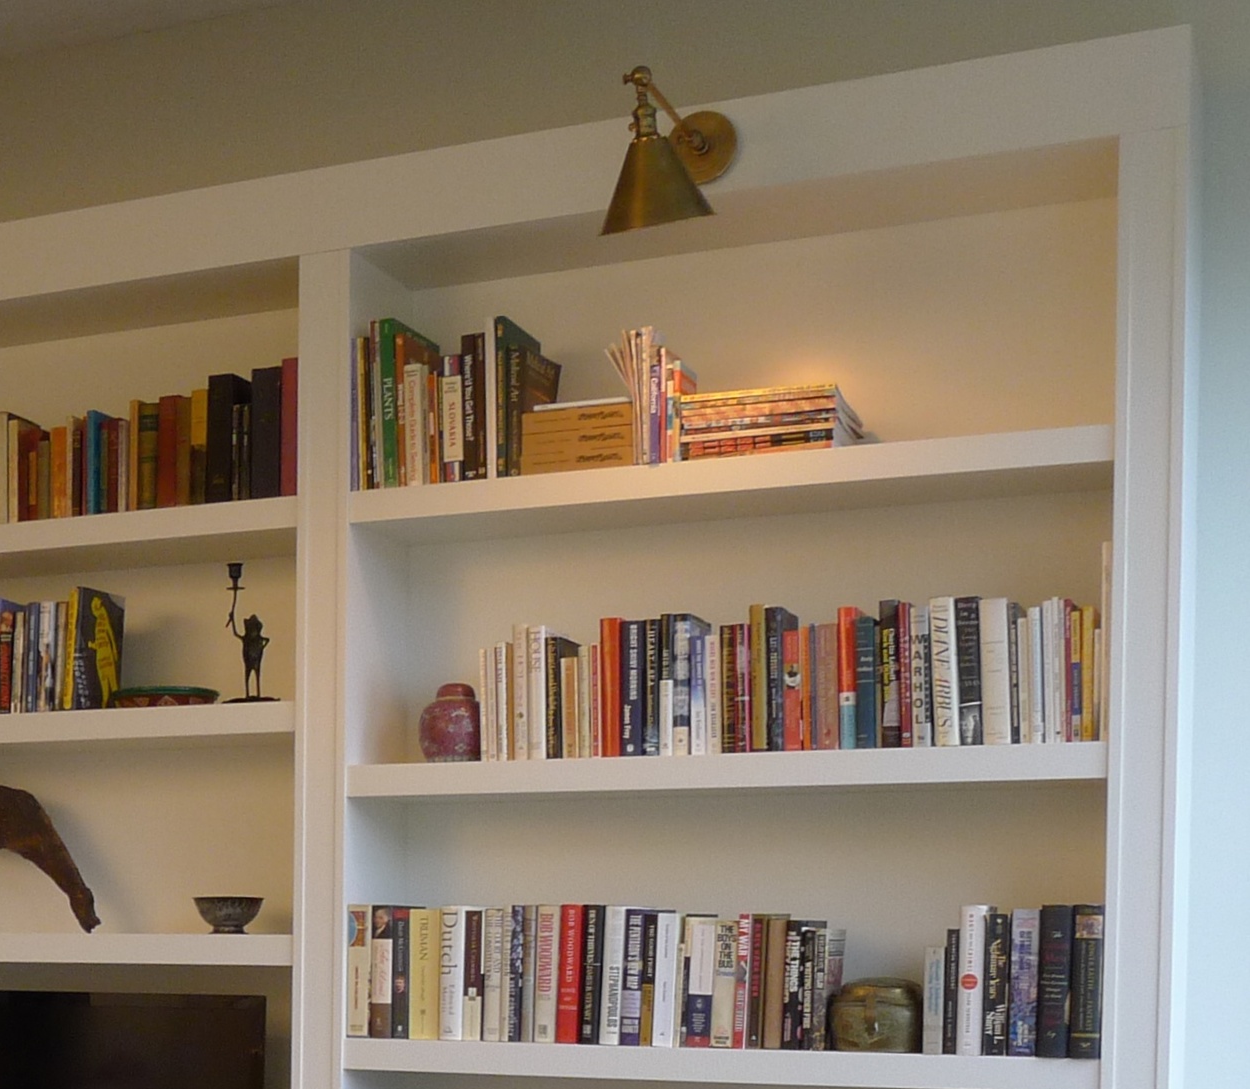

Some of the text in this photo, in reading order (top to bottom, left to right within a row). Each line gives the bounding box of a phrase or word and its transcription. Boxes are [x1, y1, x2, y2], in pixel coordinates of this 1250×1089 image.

[383, 378, 395, 421] PLANTS
[407, 379, 418, 417] Complete
[464, 354, 475, 441] Where'd You Get Those?
[511, 388, 521, 401] Art
[650, 377, 659, 414] California
[448, 402, 457, 448] SLOVAKIA
[408, 452, 419, 481] Sewing
[529, 630, 541, 674] HOUSE
[629, 624, 638, 700] BRIGHT SHINY MORNING
[647, 630, 656, 661] HEART
[910, 634, 927, 725] WARHOL
[623, 704, 632, 739] James Frey
[565, 909, 576, 927] BOB
[587, 909, 596, 924] DEN
[721, 925, 734, 934] THE
[419, 915, 429, 961] TRUMAN
[440, 911, 458, 975] Dutch
[538, 913, 554, 992] BOB WOODWARD
[565, 929, 575, 983] WOODWARD
[587, 935, 596, 963] THIEVES
[626, 915, 640, 989] THE PENTAGON'S NEW MAP
[717, 934, 737, 943] BOYS
[718, 951, 733, 960] THE
[721, 943, 732, 951] ON
[738, 919, 749, 956] MY WAR
[718, 960, 734, 968] BUS
[790, 942, 800, 993] THE THINGS
[988, 938, 1001, 1000] Nightmare Years
[998, 955, 1007, 967] The
[607, 966, 620, 1028] STEPHANOPOULOS
[803, 961, 812, 1029] WRITING UNDER FIRE
[984, 1011, 995, 1036] Shirer
[993, 1004, 1006, 1035] William
